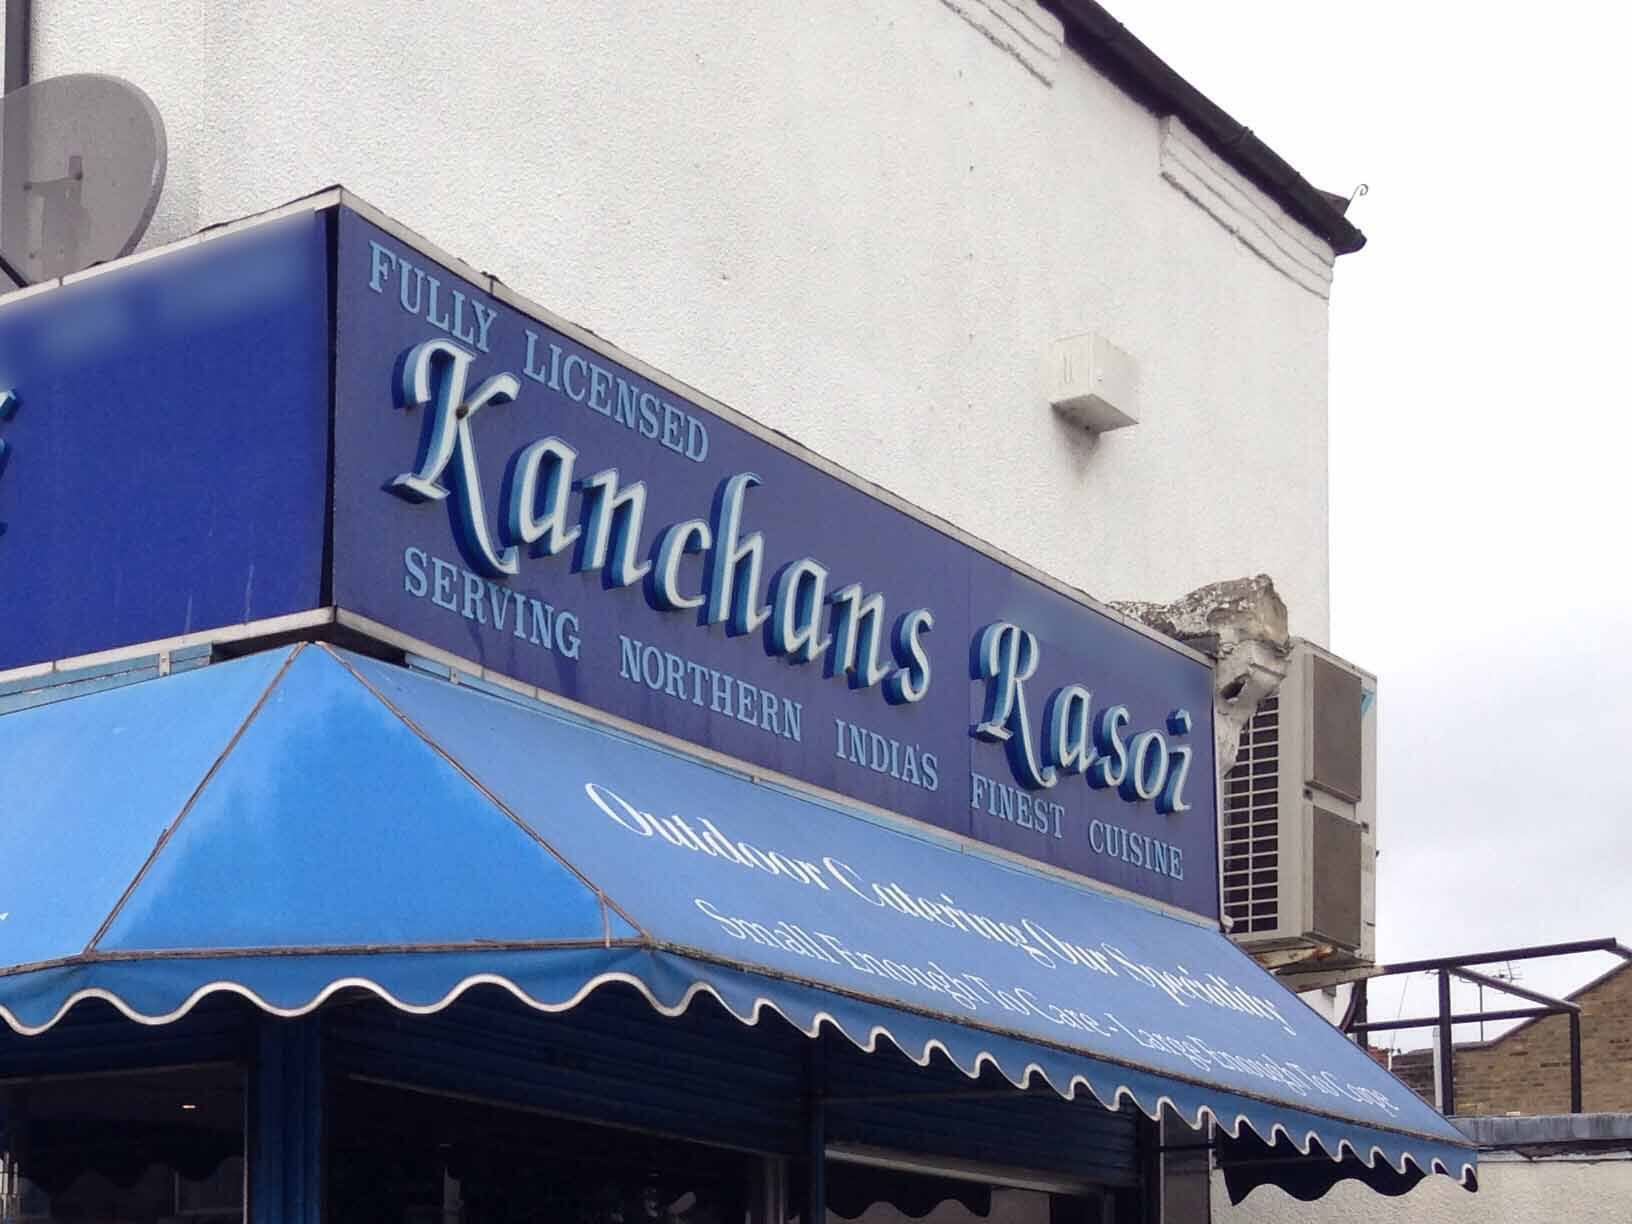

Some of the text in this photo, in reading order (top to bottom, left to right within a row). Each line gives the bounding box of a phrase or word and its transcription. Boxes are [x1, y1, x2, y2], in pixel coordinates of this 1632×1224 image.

[368, 239, 710, 464] FULLY LICENSED
[382, 338, 1193, 814] Kanchans Rasoi
[403, 546, 1184, 882] SERVING NORTHERN INDIA'S FINEST CUISINE
[583, 782, 1297, 1036] Outdoor Catering Our Speciality
[694, 898, 838, 965] Small
[814, 931, 991, 1011] Enough
[961, 972, 1031, 1016] To
[1014, 987, 1112, 1037] Care
[1104, 1012, 1212, 1072] Large
